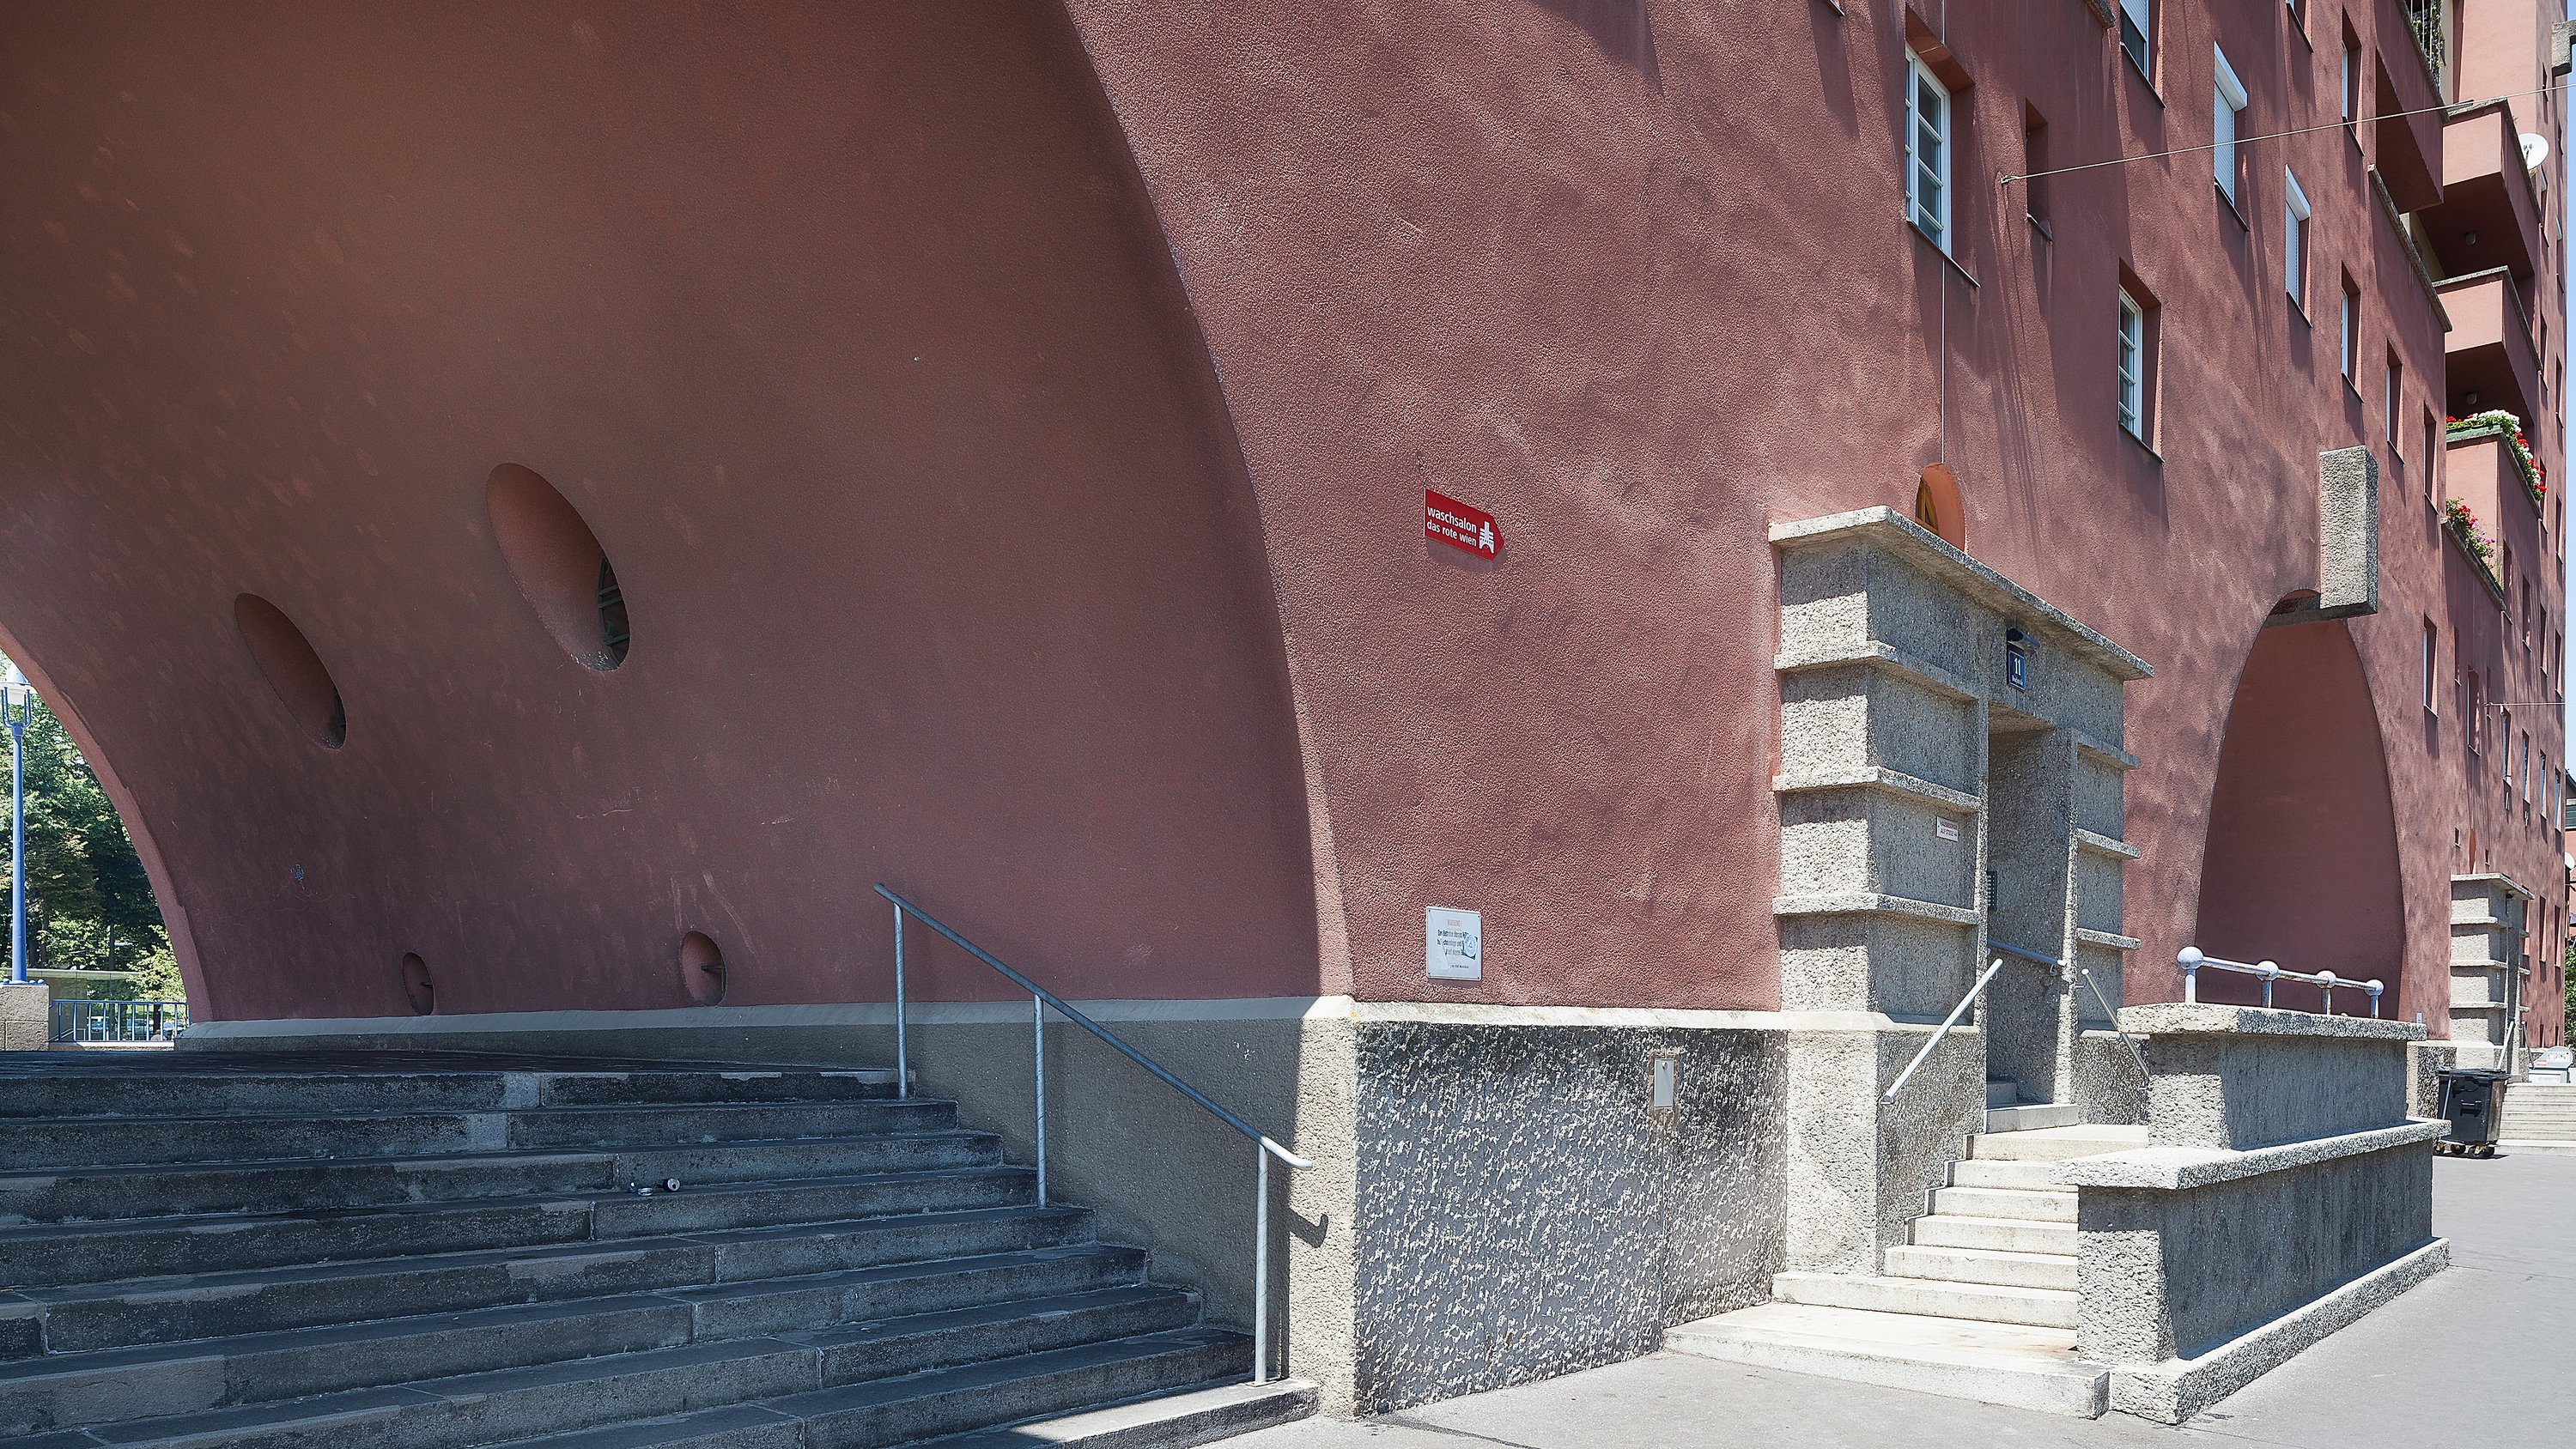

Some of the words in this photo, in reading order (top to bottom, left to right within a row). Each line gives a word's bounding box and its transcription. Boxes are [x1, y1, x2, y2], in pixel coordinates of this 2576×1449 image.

[1426, 519, 1440, 533] das
[1443, 526, 1457, 539] rote
[1459, 532, 1477, 547] wien
[1427, 506, 1477, 534] waschsalon
[2014, 658, 2021, 676] 11
